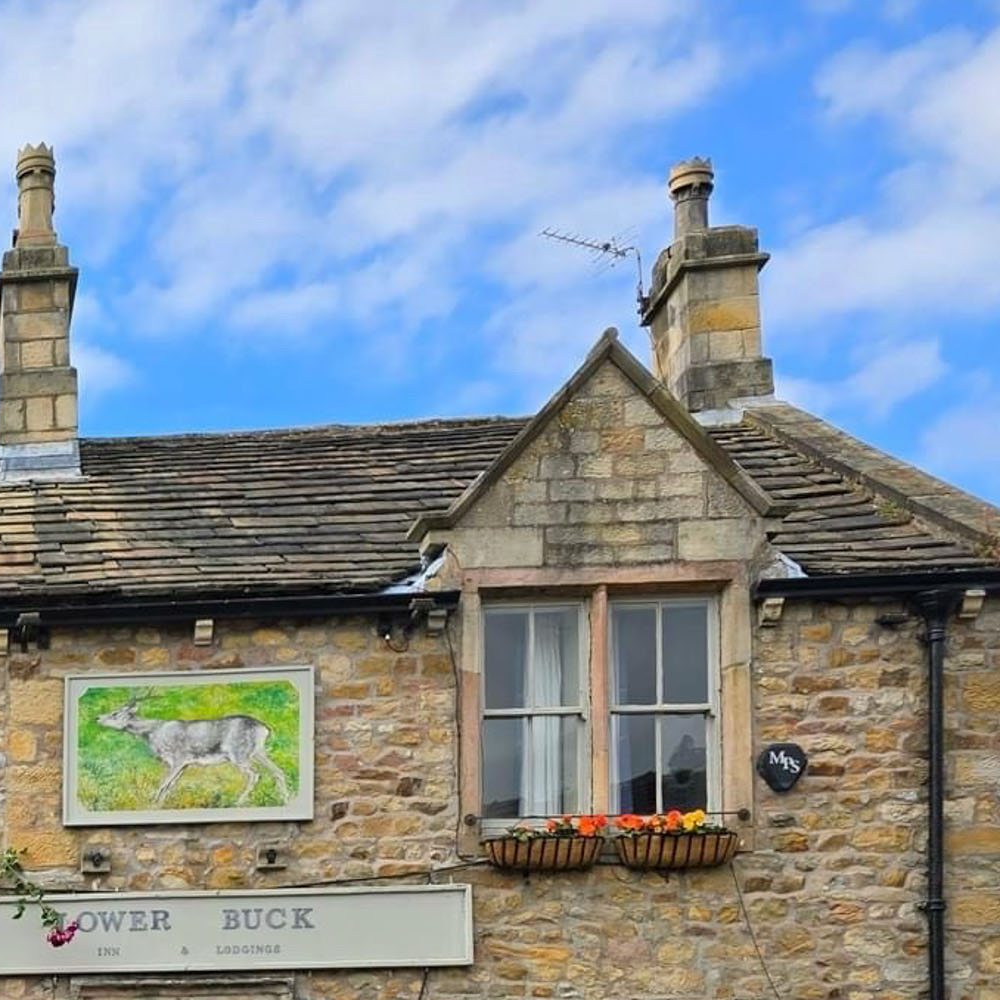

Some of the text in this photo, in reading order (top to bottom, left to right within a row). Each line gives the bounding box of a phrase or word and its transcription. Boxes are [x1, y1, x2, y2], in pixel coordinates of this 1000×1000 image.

[222, 908, 315, 931] BUCK
[98, 947, 120, 956] INN
[216, 945, 281, 955] LODGINGS
